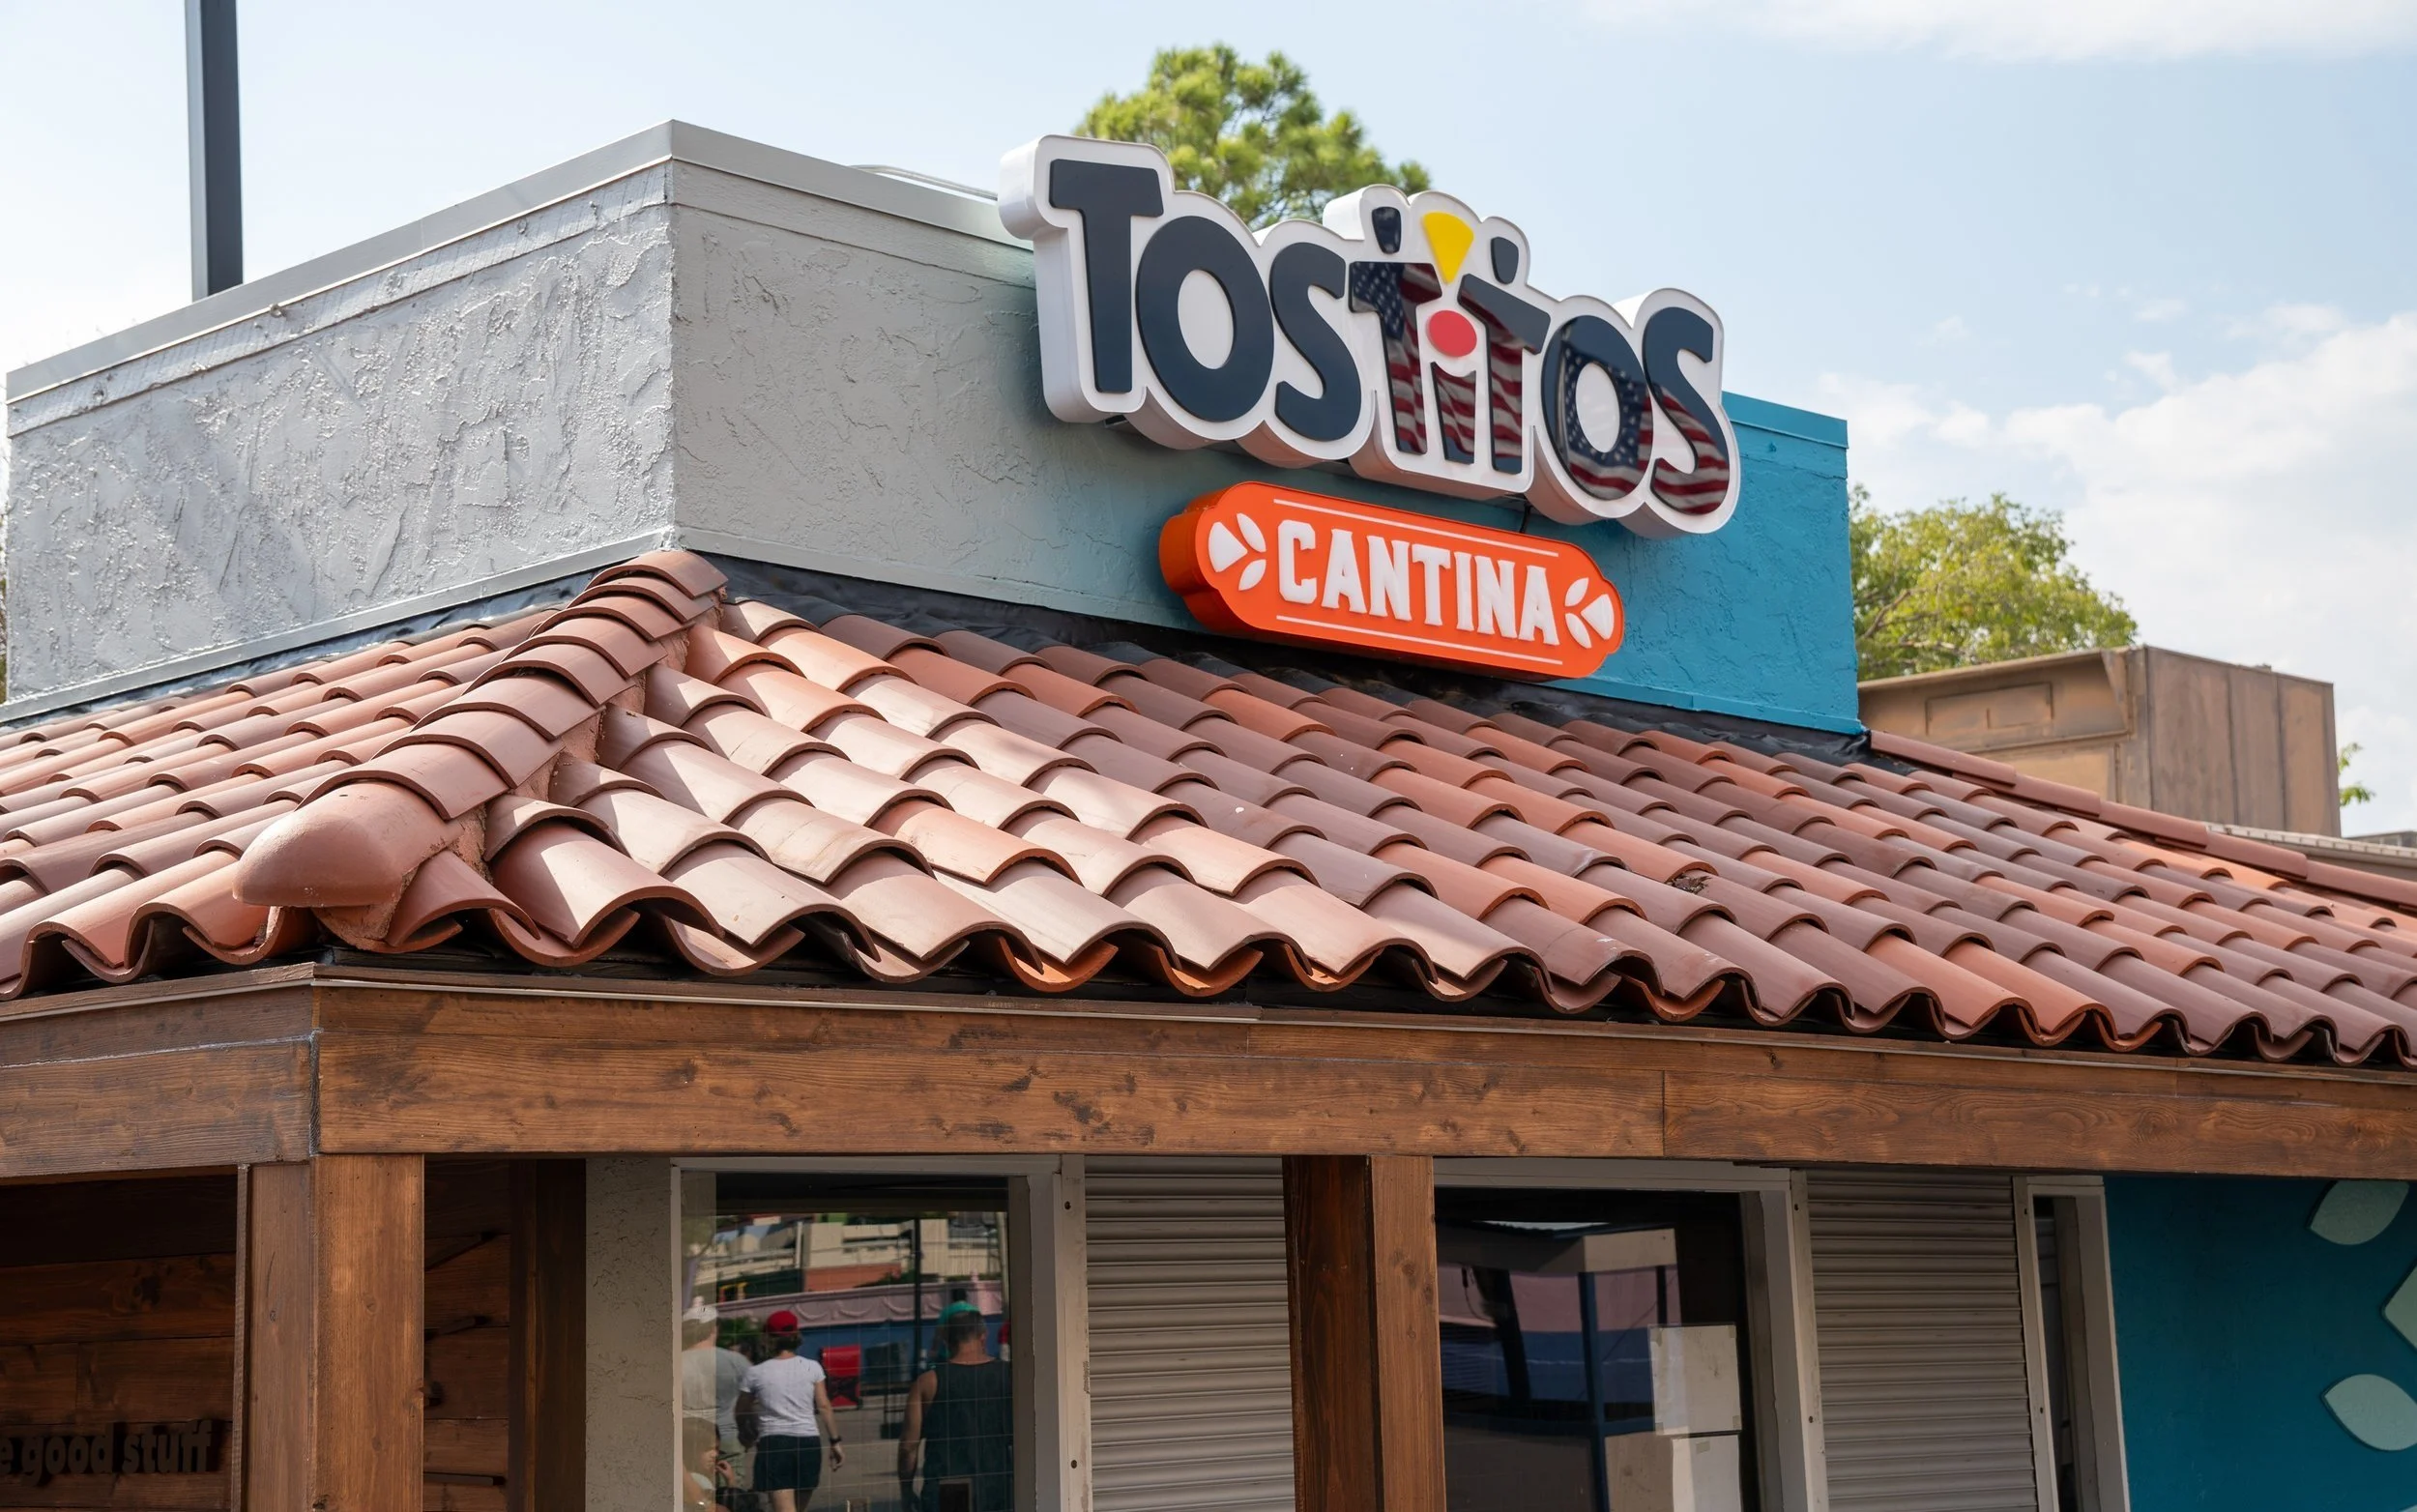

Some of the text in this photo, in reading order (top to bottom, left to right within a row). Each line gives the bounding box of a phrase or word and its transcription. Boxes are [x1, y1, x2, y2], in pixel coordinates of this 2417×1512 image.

[1277, 519, 1559, 646] CANTINA
[20, 1422, 114, 1486] good
[122, 1419, 213, 1473] stuff
